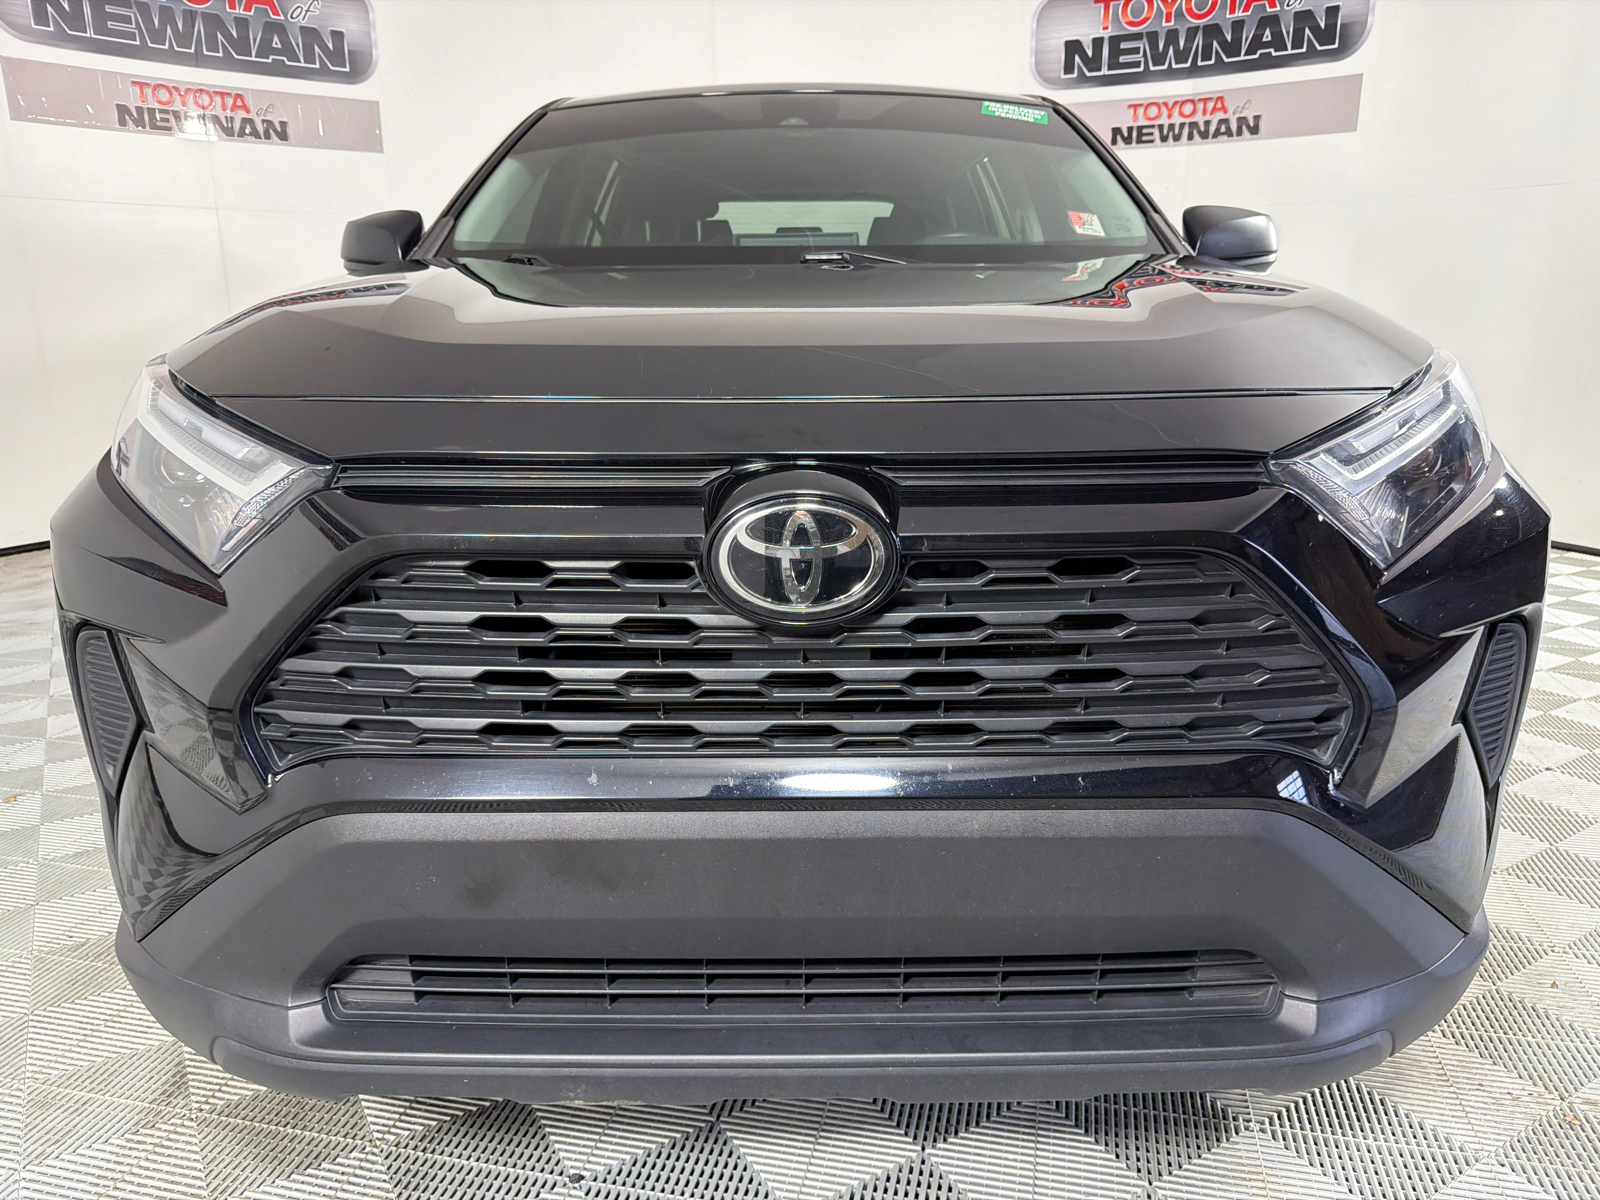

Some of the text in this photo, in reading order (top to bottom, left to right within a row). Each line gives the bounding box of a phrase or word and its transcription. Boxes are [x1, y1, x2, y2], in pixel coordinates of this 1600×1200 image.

[288, 0, 320, 22] of
[29, 0, 349, 71] NEWNAN
[1061, 3, 1342, 79] NEWNAN
[130, 80, 275, 118] TOYOTA of
[1128, 95, 1228, 123] TOYOTA
[1111, 114, 1262, 146] NEWNAN
